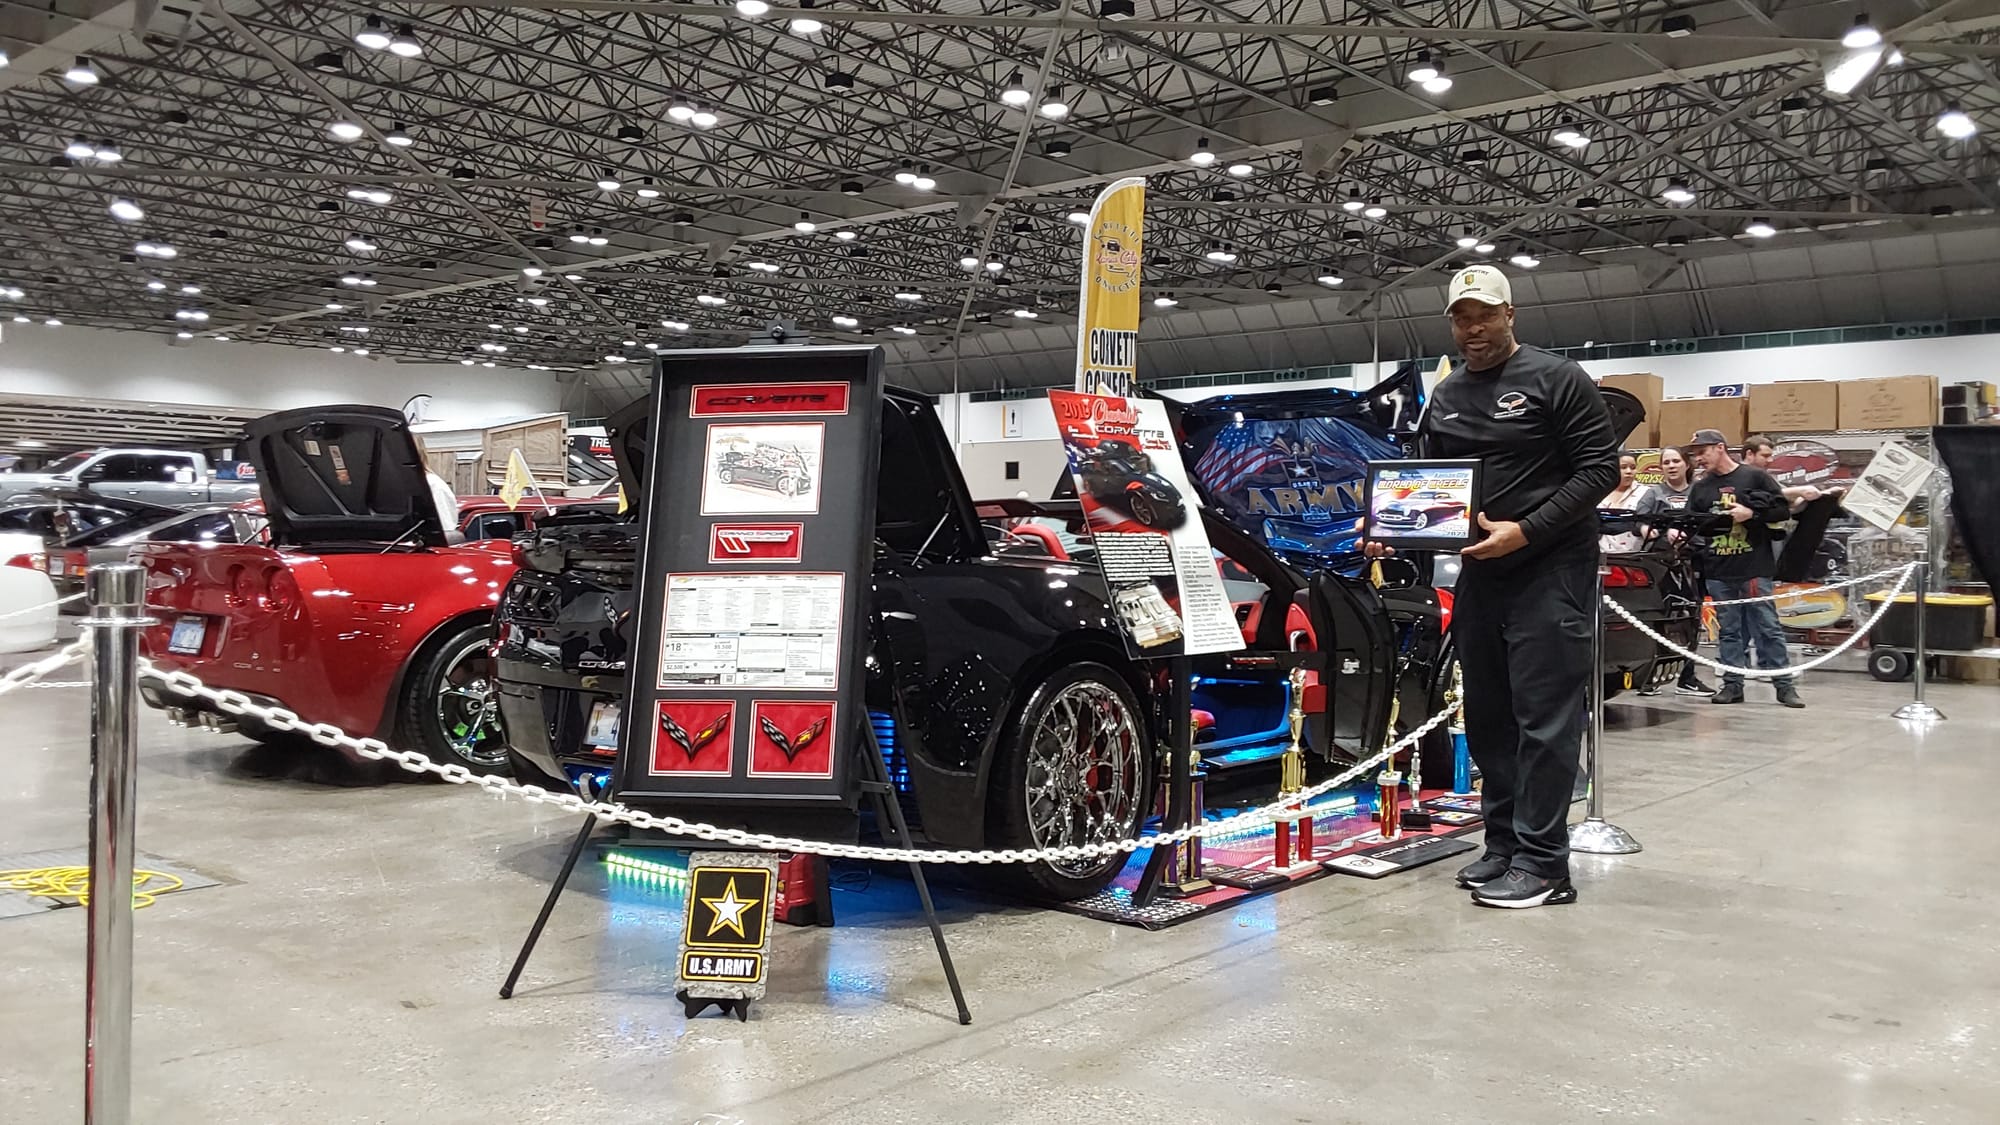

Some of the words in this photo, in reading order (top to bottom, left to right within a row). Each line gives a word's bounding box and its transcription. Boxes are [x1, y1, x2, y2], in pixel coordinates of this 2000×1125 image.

[1096, 425, 1165, 438] CORVETTE
[1246, 479, 1366, 516] ARMY
[1370, 837, 1442, 858] CORVETTE
